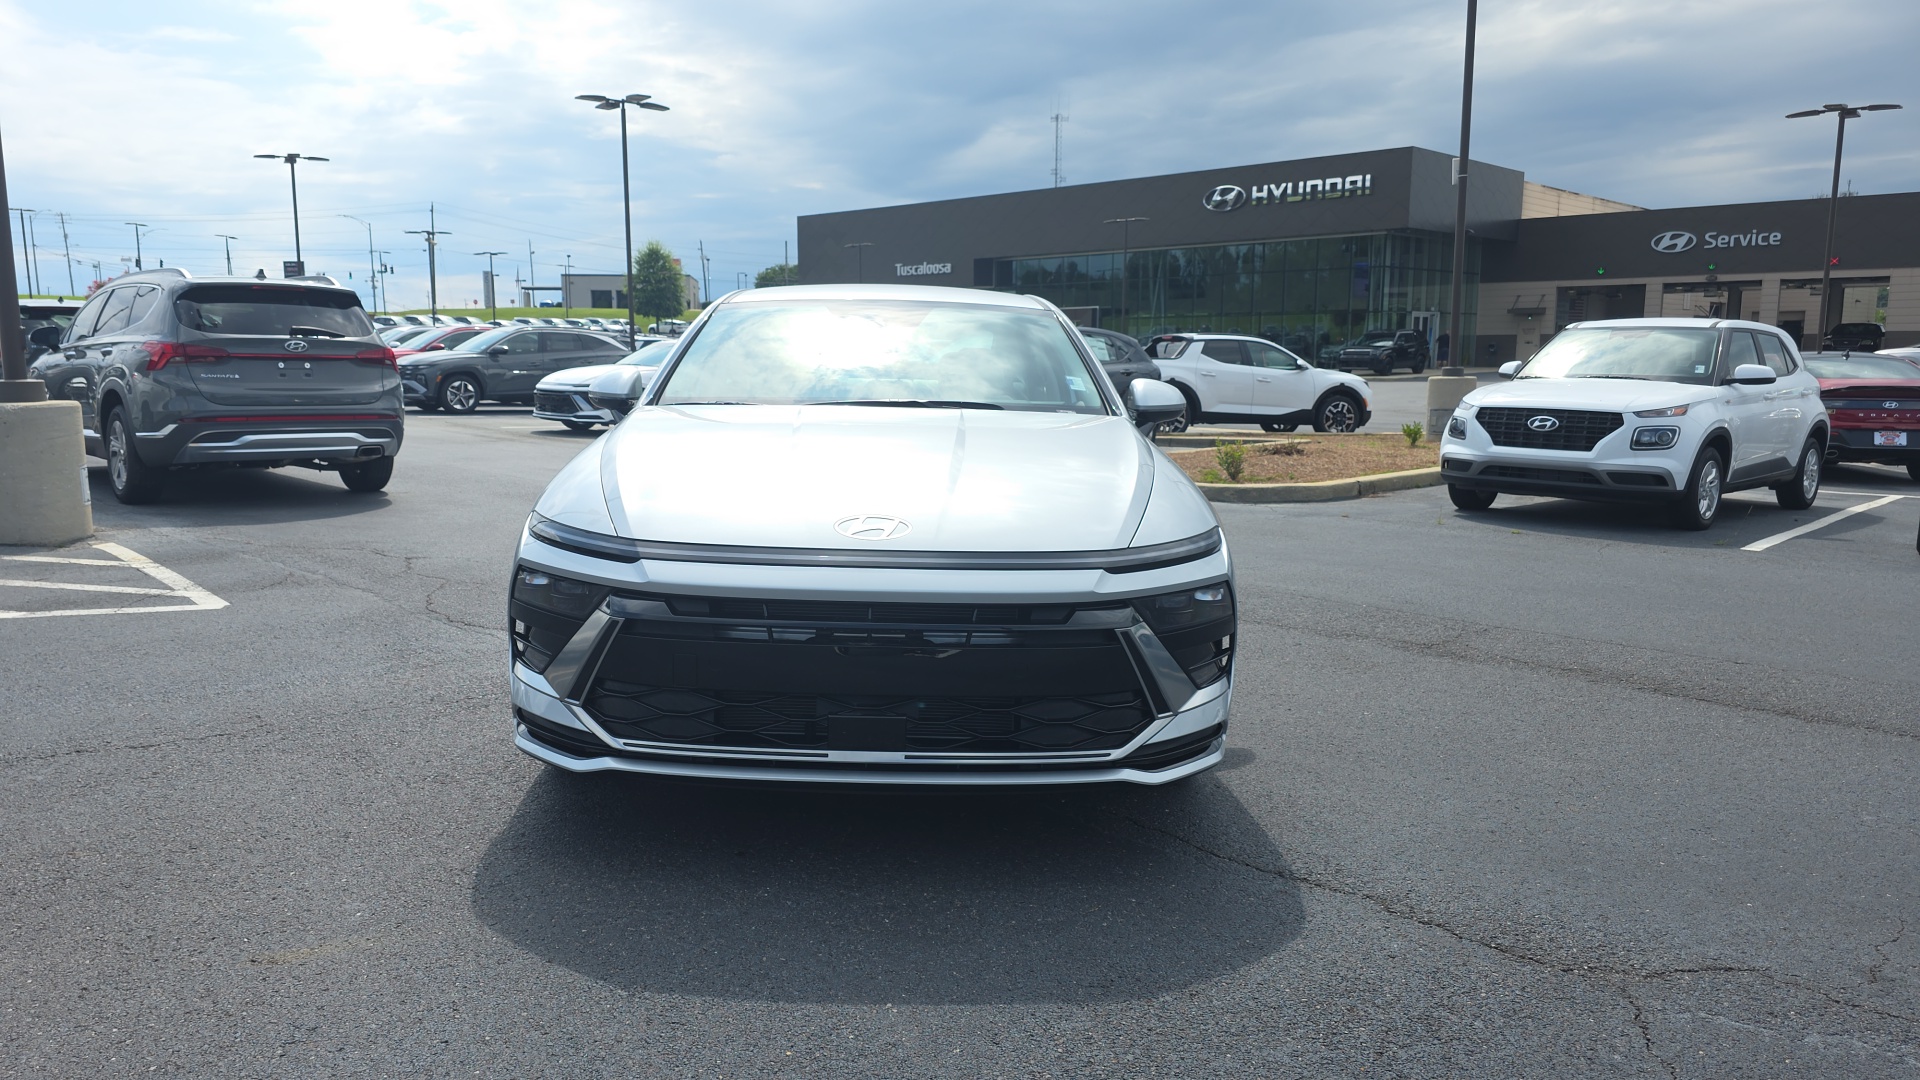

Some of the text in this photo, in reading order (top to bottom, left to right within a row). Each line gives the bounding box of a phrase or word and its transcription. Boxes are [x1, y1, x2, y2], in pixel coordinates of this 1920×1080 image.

[1251, 173, 1371, 205] HYUNDAI
[1703, 229, 1782, 249] Service
[894, 261, 952, 277] Tuscaloosa
